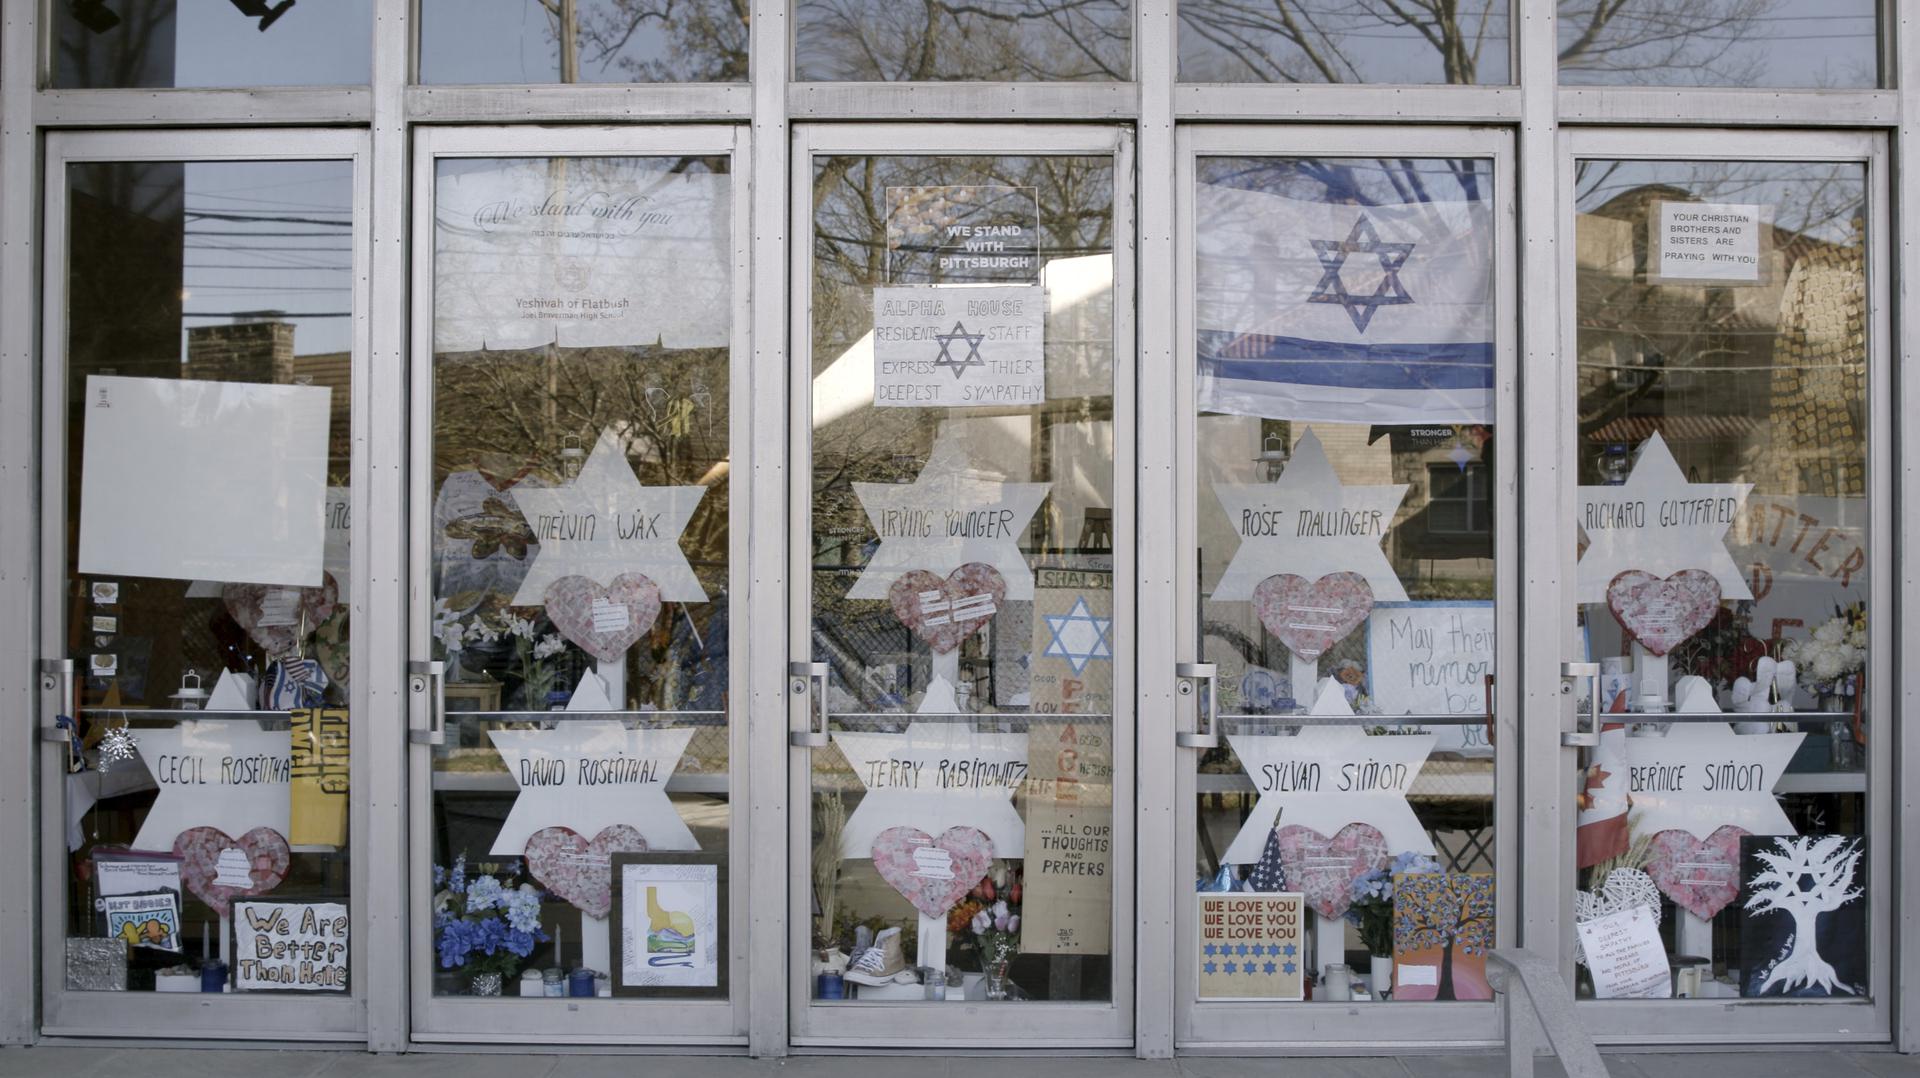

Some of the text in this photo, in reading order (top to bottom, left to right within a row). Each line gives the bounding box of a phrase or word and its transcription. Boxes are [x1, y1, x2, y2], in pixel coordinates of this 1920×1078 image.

[1673, 213, 1749, 223] YOUR CHRISTIAN
[947, 225, 1021, 237] WE STAND
[1670, 225, 1742, 235] BROTHERS AND
[965, 241, 1004, 252] WITH
[1670, 237, 1735, 246] SISTERS ARE
[940, 257, 1029, 269] PITTSBURGH
[1664, 252, 1756, 264] PRAYING WITH YOU
[516, 298, 630, 309] Yeshivah of Flatbush
[882, 300, 1024, 317] ALPHA HOUSE
[580, 312, 598, 321] High
[876, 325, 1033, 342] RESIDENTS STAFF
[882, 359, 1035, 375] EXPRESS THIER
[879, 384, 1043, 401] DEEPEST SYMPATHY
[1410, 429, 1452, 437] STRONGER
[536, 508, 660, 541] MELVIN WAX
[881, 502, 1014, 540] IRVING YOUNGER
[1241, 503, 1383, 537] ROSE MALLINGER
[1585, 501, 1645, 531] RICHARD
[1390, 615, 1434, 663] May
[1409, 660, 1489, 688] memor
[1444, 686, 1481, 714] be
[157, 753, 290, 785] CECIL ROSENTHA
[520, 751, 658, 787] DAVID ROSENTHAL
[864, 757, 1029, 789] JERRY RABINOWITZ
[1262, 758, 1407, 792] SYLVAN SIMON
[1629, 760, 1764, 792] BERNICE SIMON
[1054, 824, 1077, 835] ALL
[1082, 825, 1110, 837] OUR
[1041, 836, 1109, 853] THOUGHTS
[1042, 859, 1105, 876] PRAYERS
[1204, 900, 1297, 913] WE LOVE YOU
[245, 906, 347, 937] We Are
[1204, 914, 1297, 926] WE LOVE YOU
[1204, 927, 1297, 940] WE LOVE YOU
[254, 934, 345, 963] Better
[239, 959, 347, 986] Than Hate
